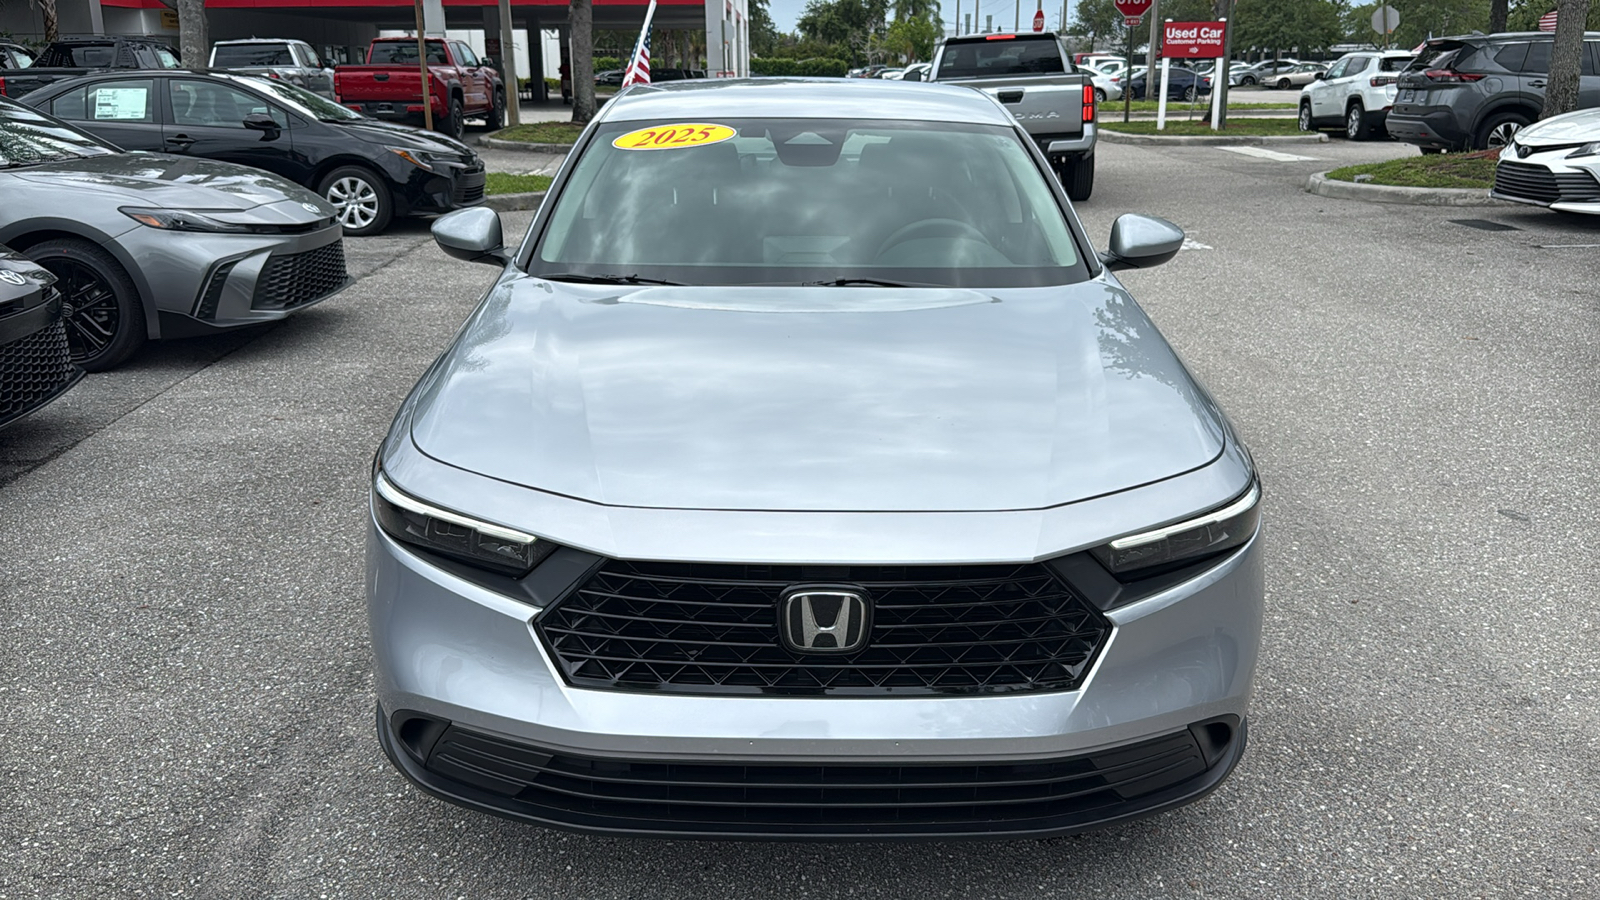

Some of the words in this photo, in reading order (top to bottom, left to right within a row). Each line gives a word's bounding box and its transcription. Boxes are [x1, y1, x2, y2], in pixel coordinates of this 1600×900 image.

[1033, 18, 1044, 28] STOP
[1166, 27, 1197, 38] Used
[1200, 27, 1223, 38] Car
[1197, 38, 1221, 46] Parking
[1014, 111, 1060, 120] OMA
[632, 126, 716, 147] 2025
